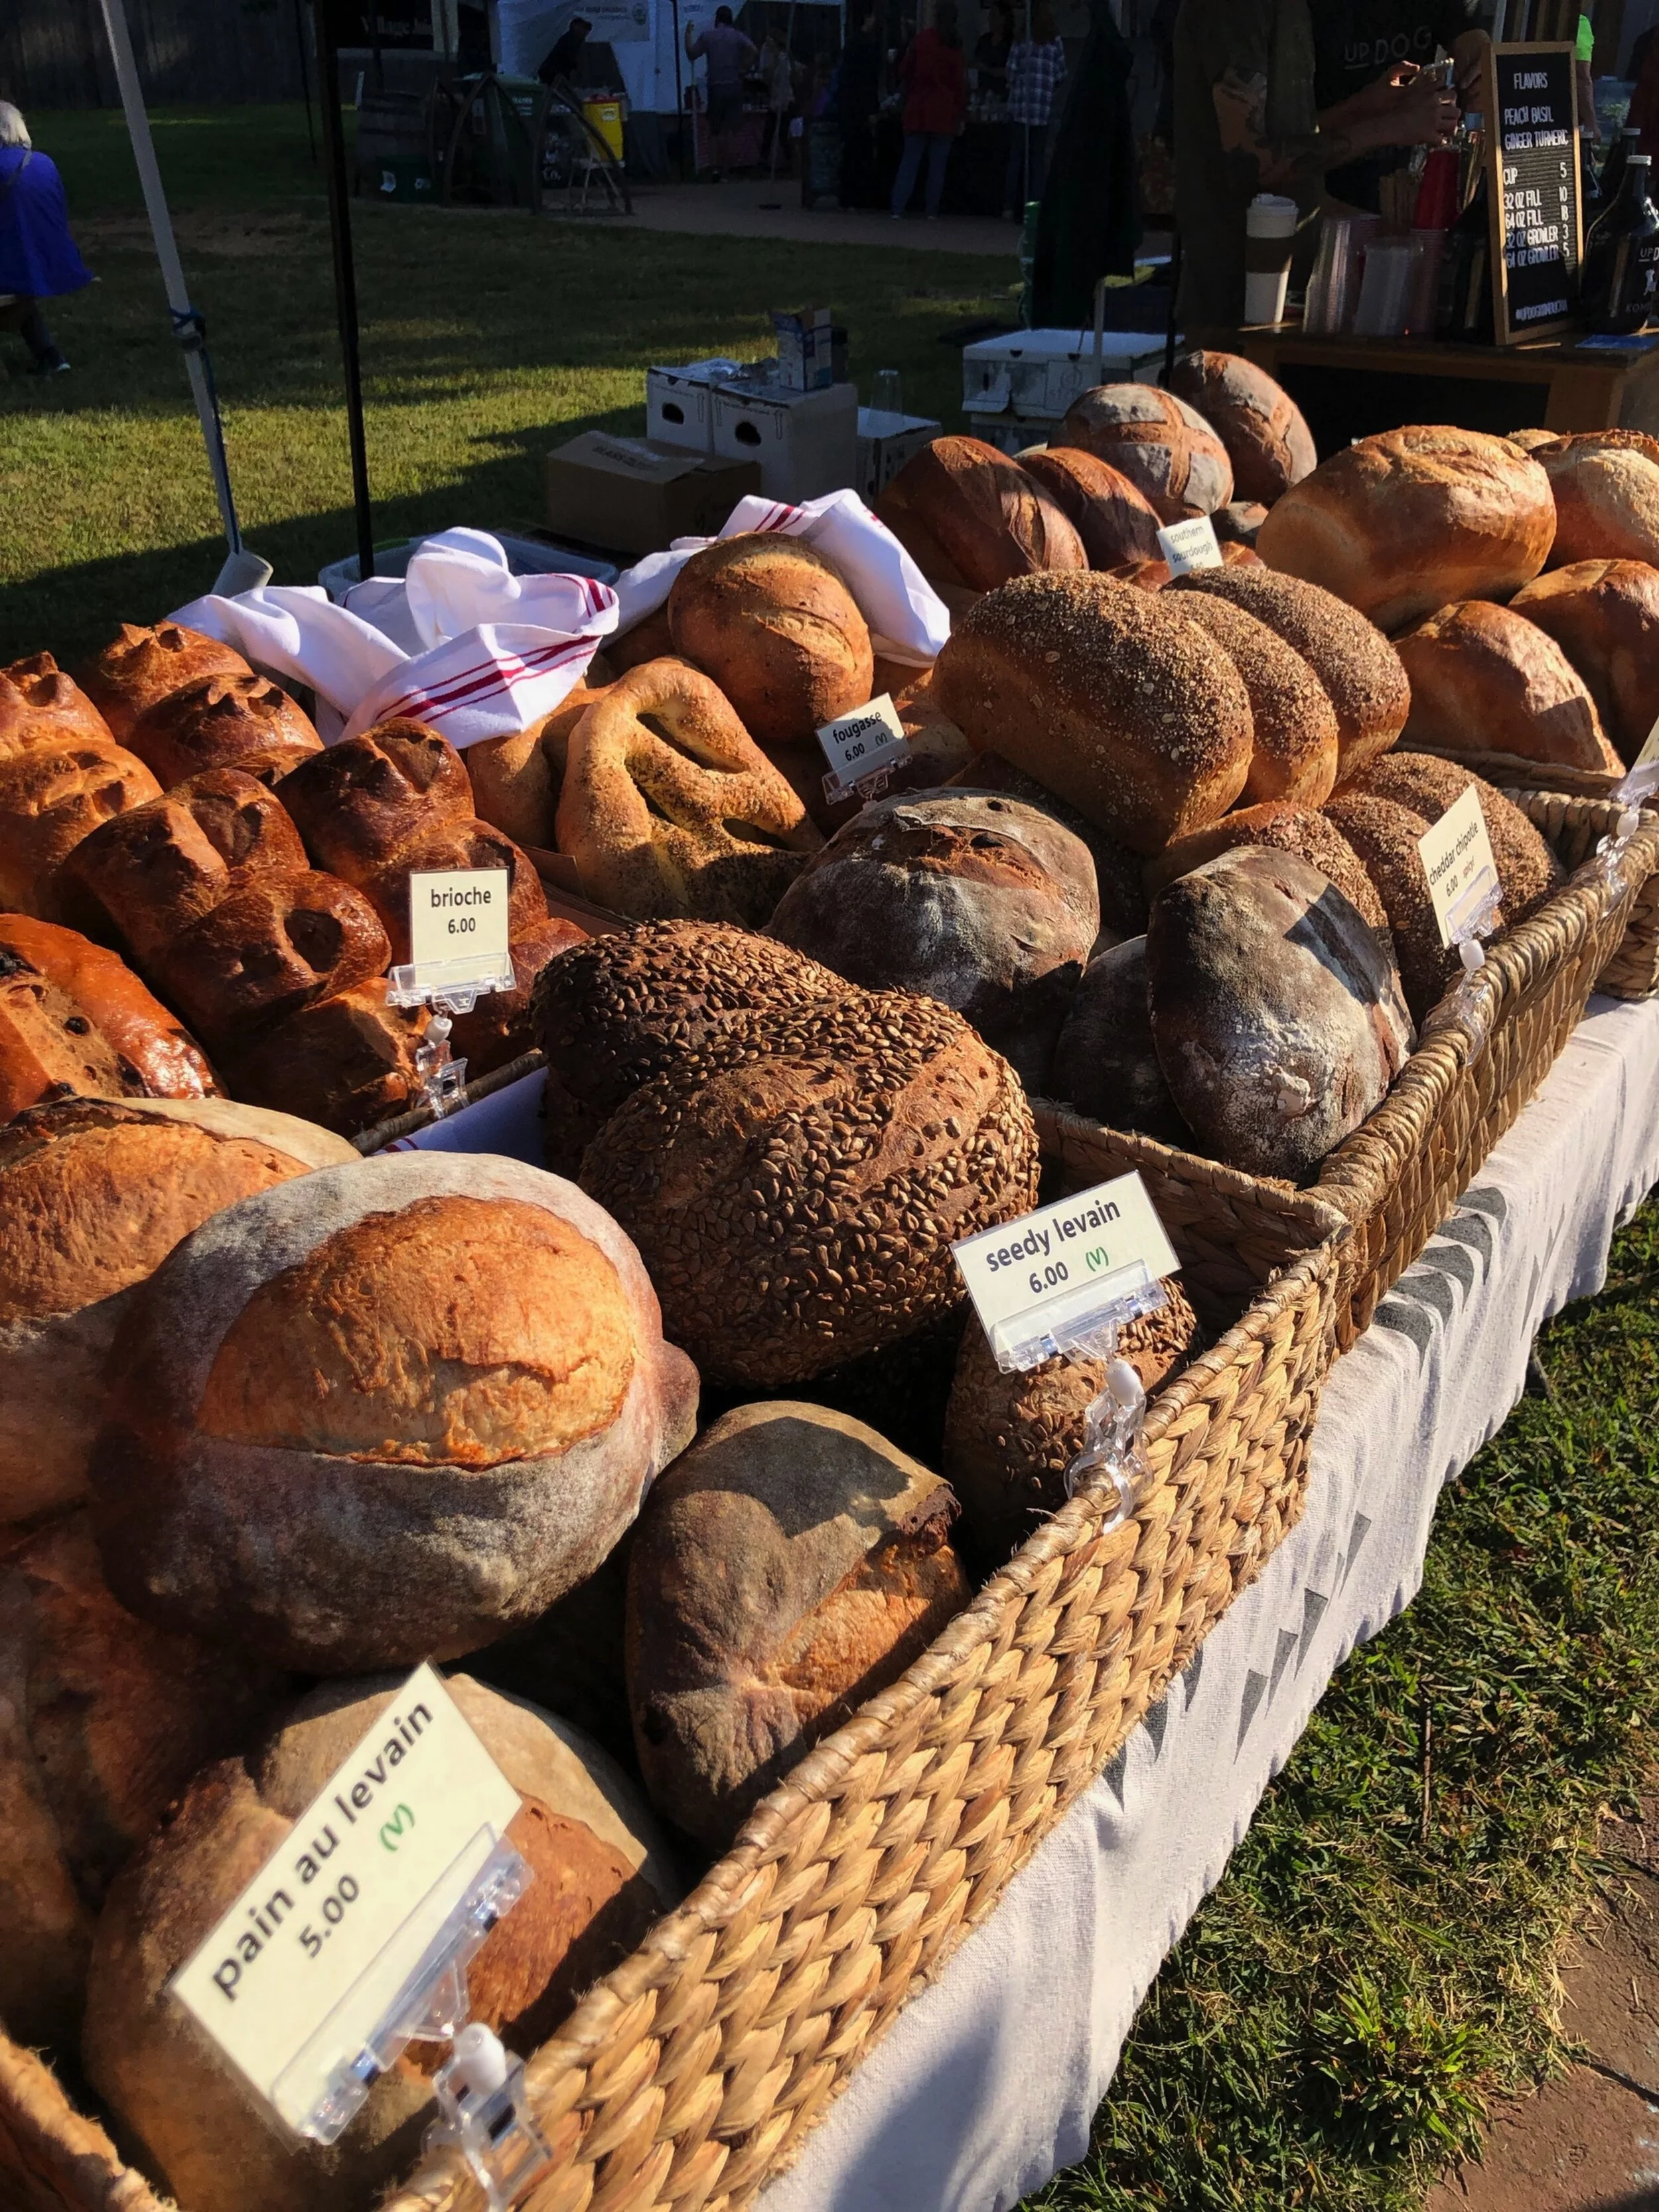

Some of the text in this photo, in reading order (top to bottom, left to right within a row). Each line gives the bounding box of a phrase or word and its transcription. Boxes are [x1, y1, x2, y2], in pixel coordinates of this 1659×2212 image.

[1514, 72, 1548, 90] FLAVORS
[1504, 106, 1554, 125] PEACH BASIL
[1504, 129, 1569, 151] GINGER TURMERIC
[1503, 162, 1567, 185] CUP 5
[1504, 186, 1567, 209] 32 OZ FILL 10
[1505, 205, 1569, 230] 64 OZ FILL 18
[1506, 224, 1569, 249] 32 OZ GROWLER 3
[1506, 242, 1570, 269] 64 OZ GROWLER 5
[1171, 526, 1204, 543] southern
[1172, 540, 1213, 563] sourdough
[833, 711, 883, 744] fougasse
[845, 743, 865, 762] 6.00
[1429, 822, 1479, 886] cheddar chipotle
[431, 887, 491, 907] brioche
[1445, 875, 1459, 897] 6.00
[448, 918, 476, 934] 6.00
[986, 1200, 1121, 1272] seedy levain
[1029, 1262, 1069, 1293] 6.00
[212, 1702, 434, 2004] pain au levain
[298, 1874, 360, 1958] 5.00
